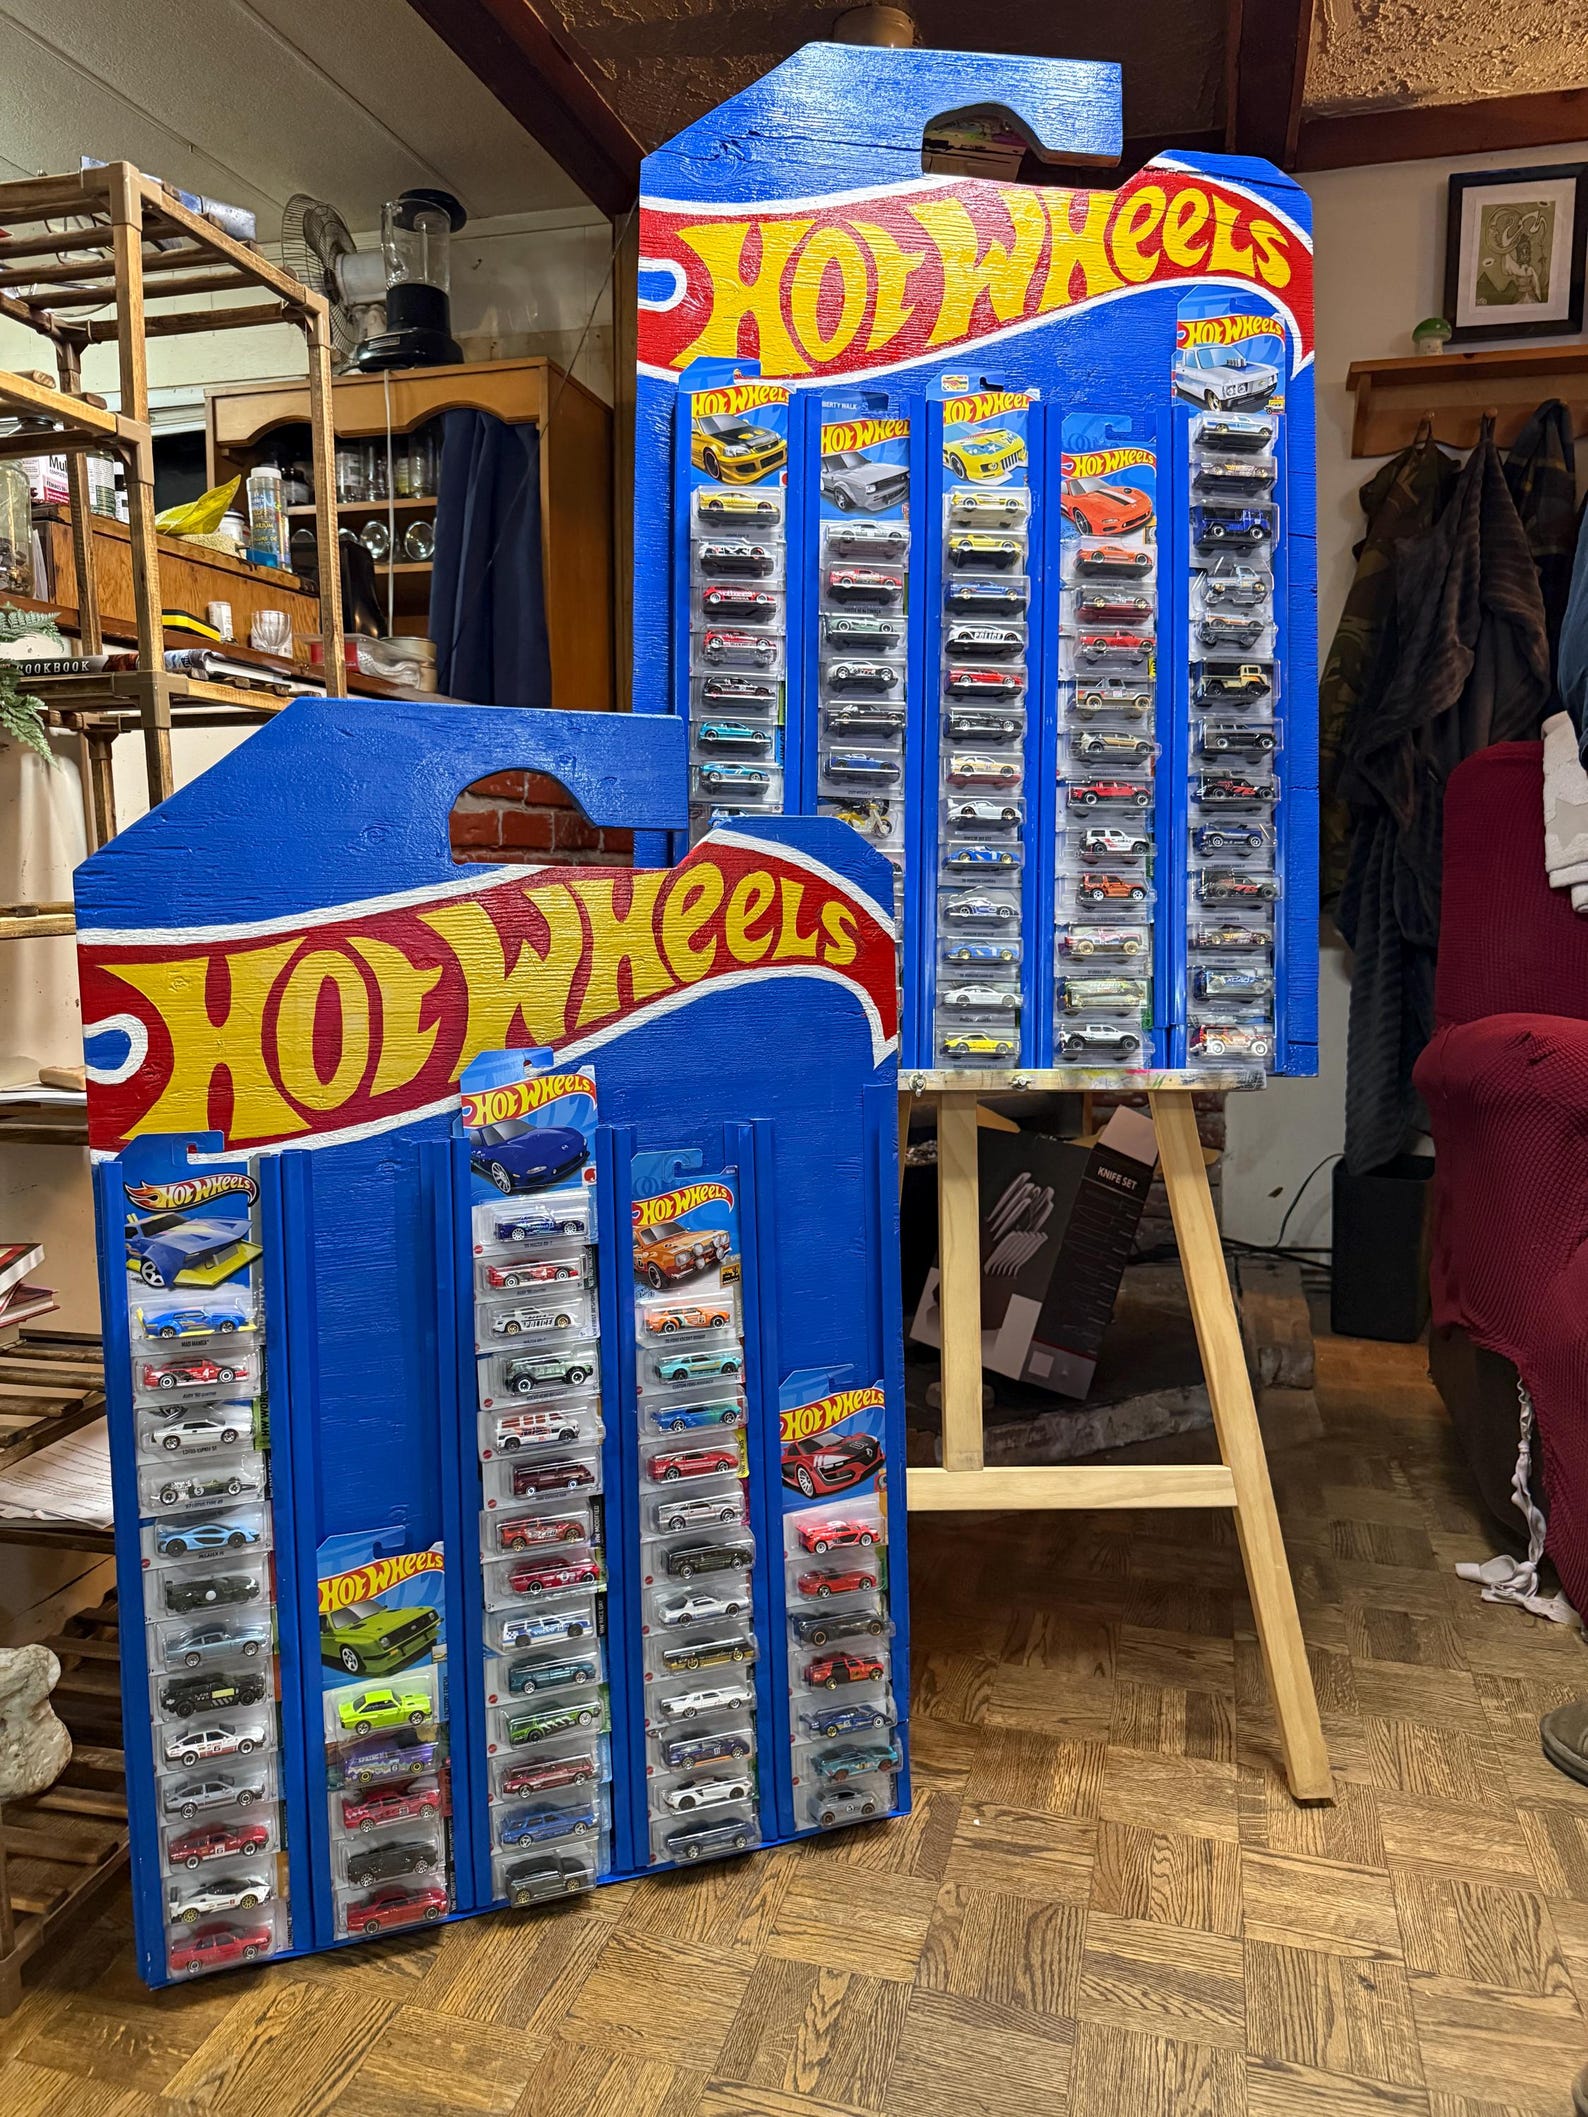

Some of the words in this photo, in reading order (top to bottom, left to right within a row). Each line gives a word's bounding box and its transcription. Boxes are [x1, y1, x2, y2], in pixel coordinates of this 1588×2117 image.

[1098, 1166, 1122, 1184] KNIFE
[1122, 1176, 1137, 1190] SET
[262, 1419, 270, 1437] HW
